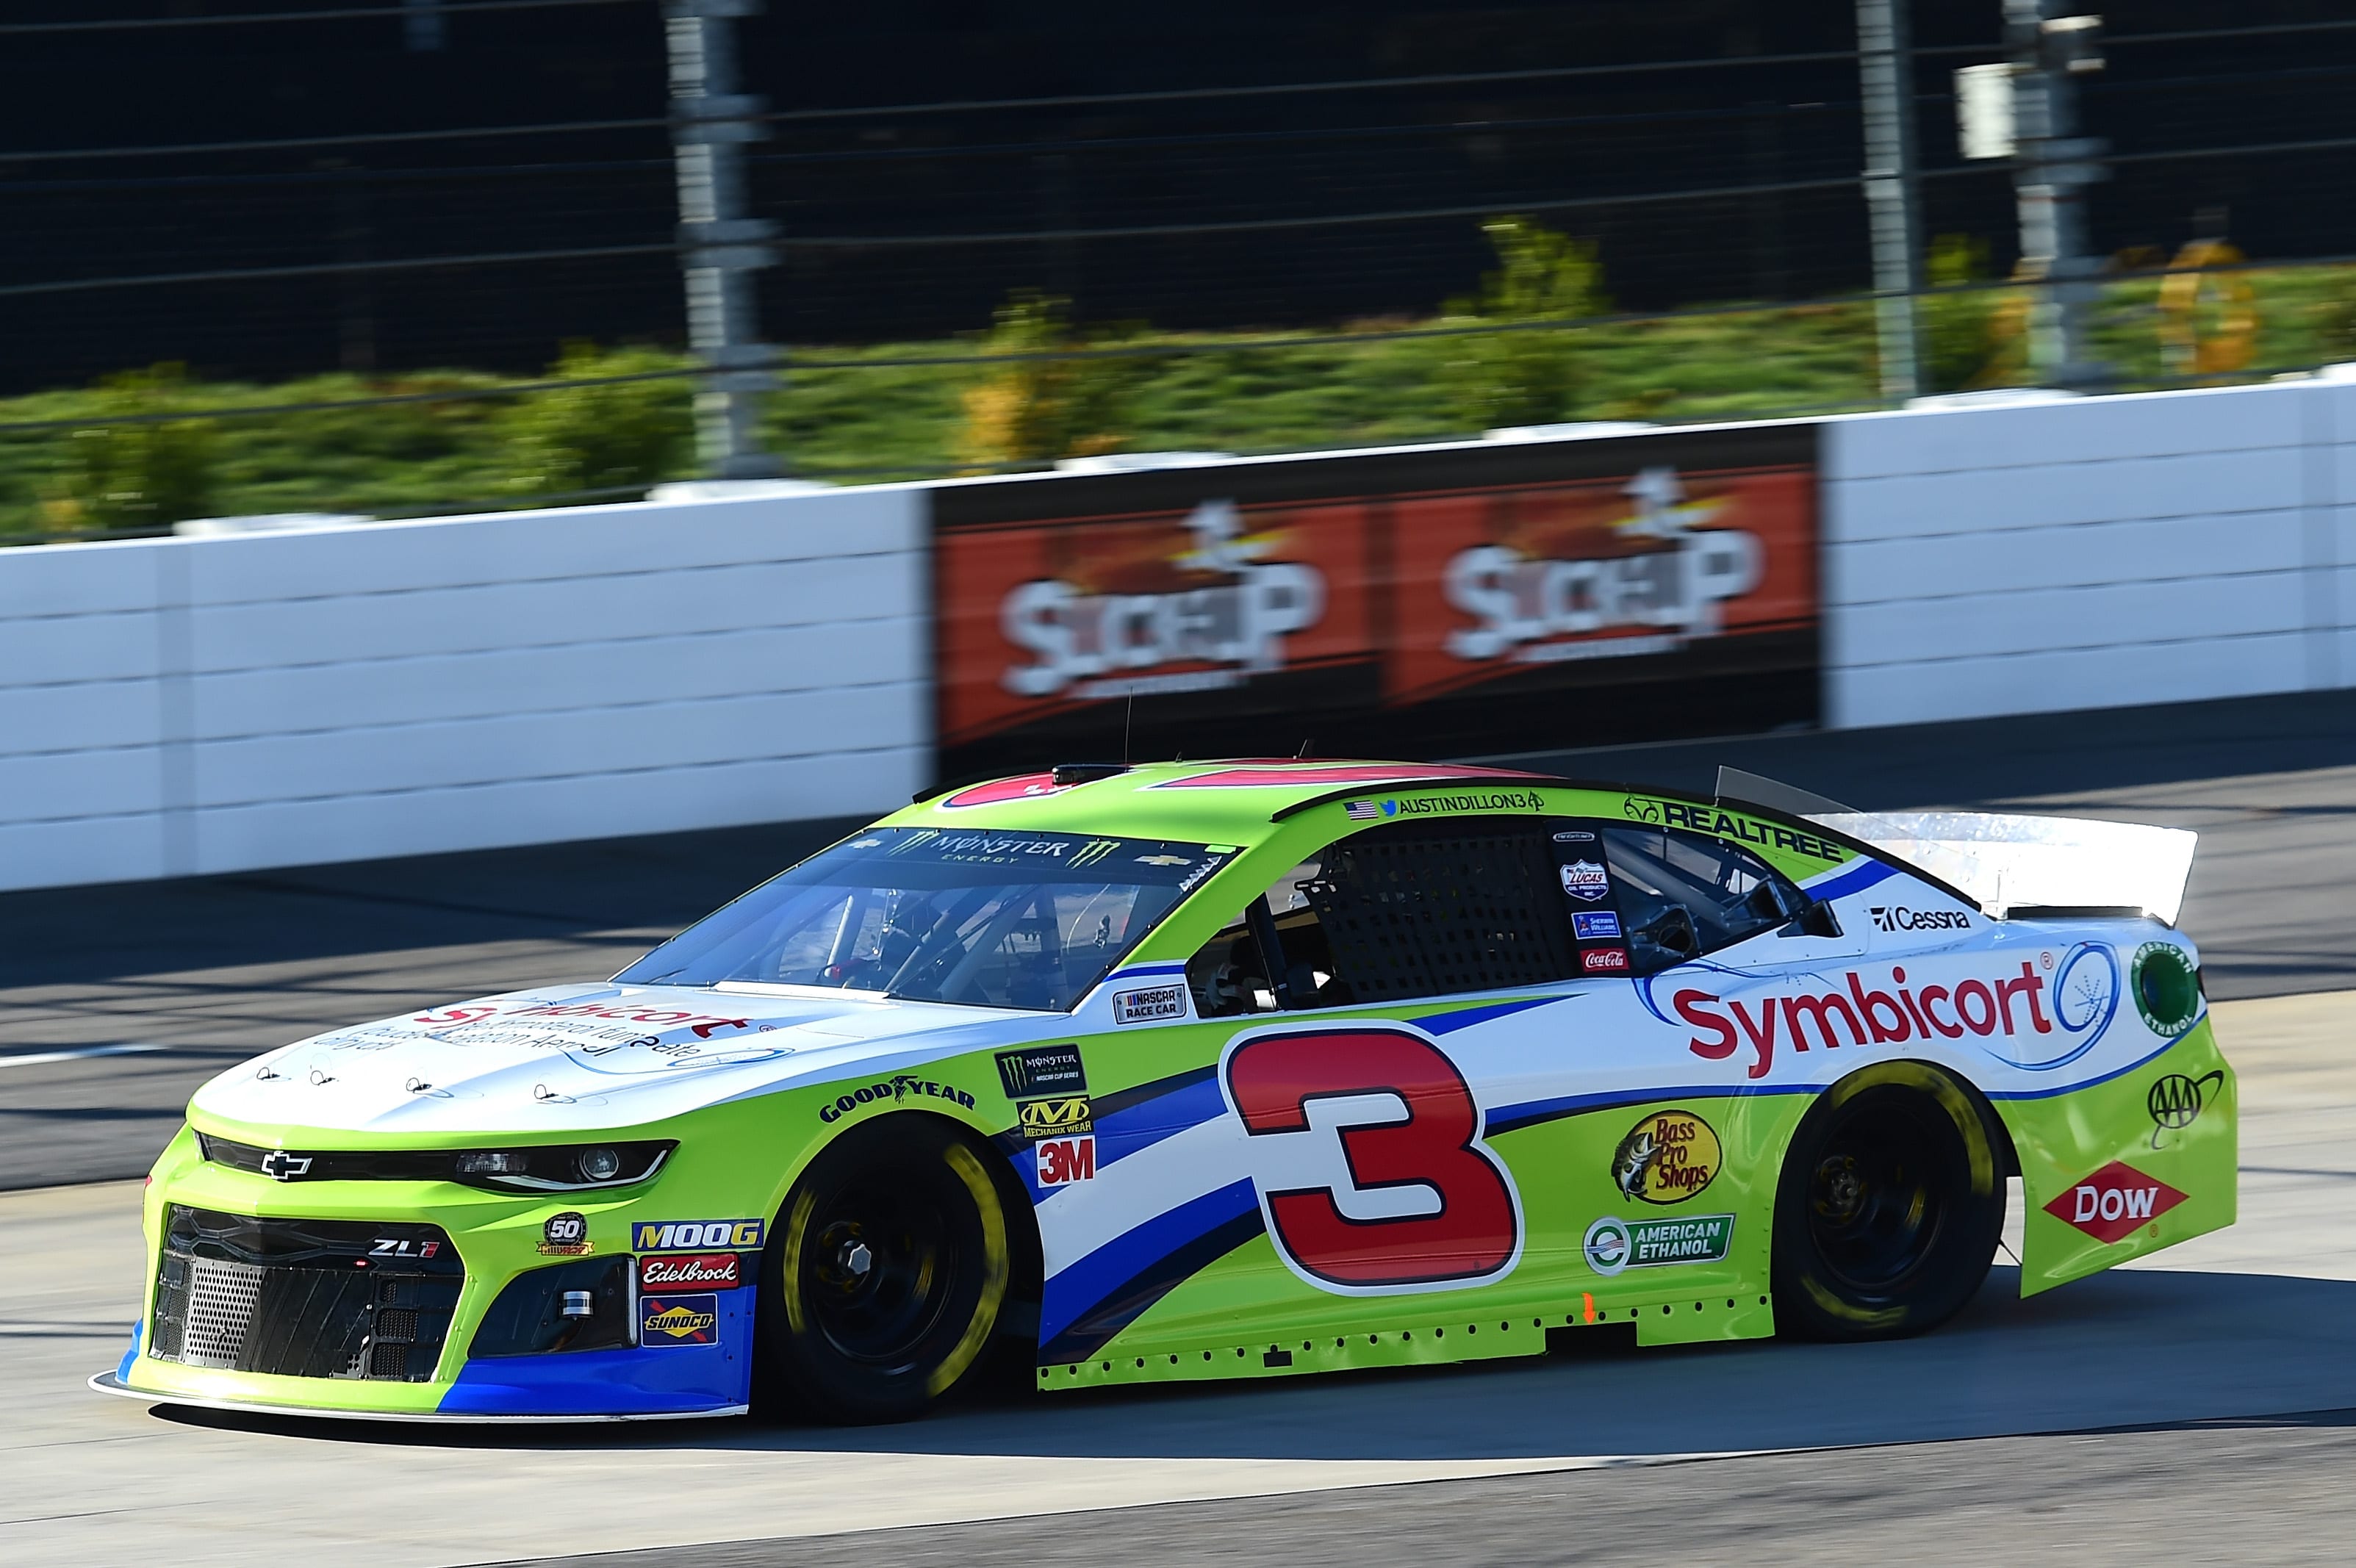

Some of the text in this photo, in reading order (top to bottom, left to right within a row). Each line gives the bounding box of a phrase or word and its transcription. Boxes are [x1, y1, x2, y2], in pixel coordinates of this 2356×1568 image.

[1399, 794, 1527, 815] AUSTINDILLON3
[1662, 802, 1845, 864] REALTREE
[941, 853, 1020, 864] ENERGY
[1570, 873, 1603, 884] LUCAS
[1896, 907, 1971, 932] Cessna
[2133, 942, 2194, 974] AMERICAN
[1136, 990, 1177, 1006] NASCAR
[1125, 1003, 1177, 1018] RACE CAR
[1672, 960, 2053, 1080] Symbicort
[2144, 1013, 2193, 1035] ETHANOL
[2150, 1075, 2202, 1129] AAA
[1023, 1120, 1092, 1138] MECHANIX WEAR
[1655, 1118, 1695, 1145] Bass
[1038, 1138, 1096, 1183] 3M
[1225, 1026, 1518, 1288] 3
[1656, 1143, 1688, 1165] Pro
[1655, 1164, 1709, 1193] Shops
[550, 1220, 580, 1239] 50
[637, 1222, 761, 1249] MOOG
[1634, 1222, 1721, 1244] AMERICAN
[368, 1238, 440, 1259] ZL1
[1638, 1239, 1713, 1260] ETHANOL
[642, 1261, 737, 1284] Edelbrock
[645, 1315, 712, 1330] SUNOCO
